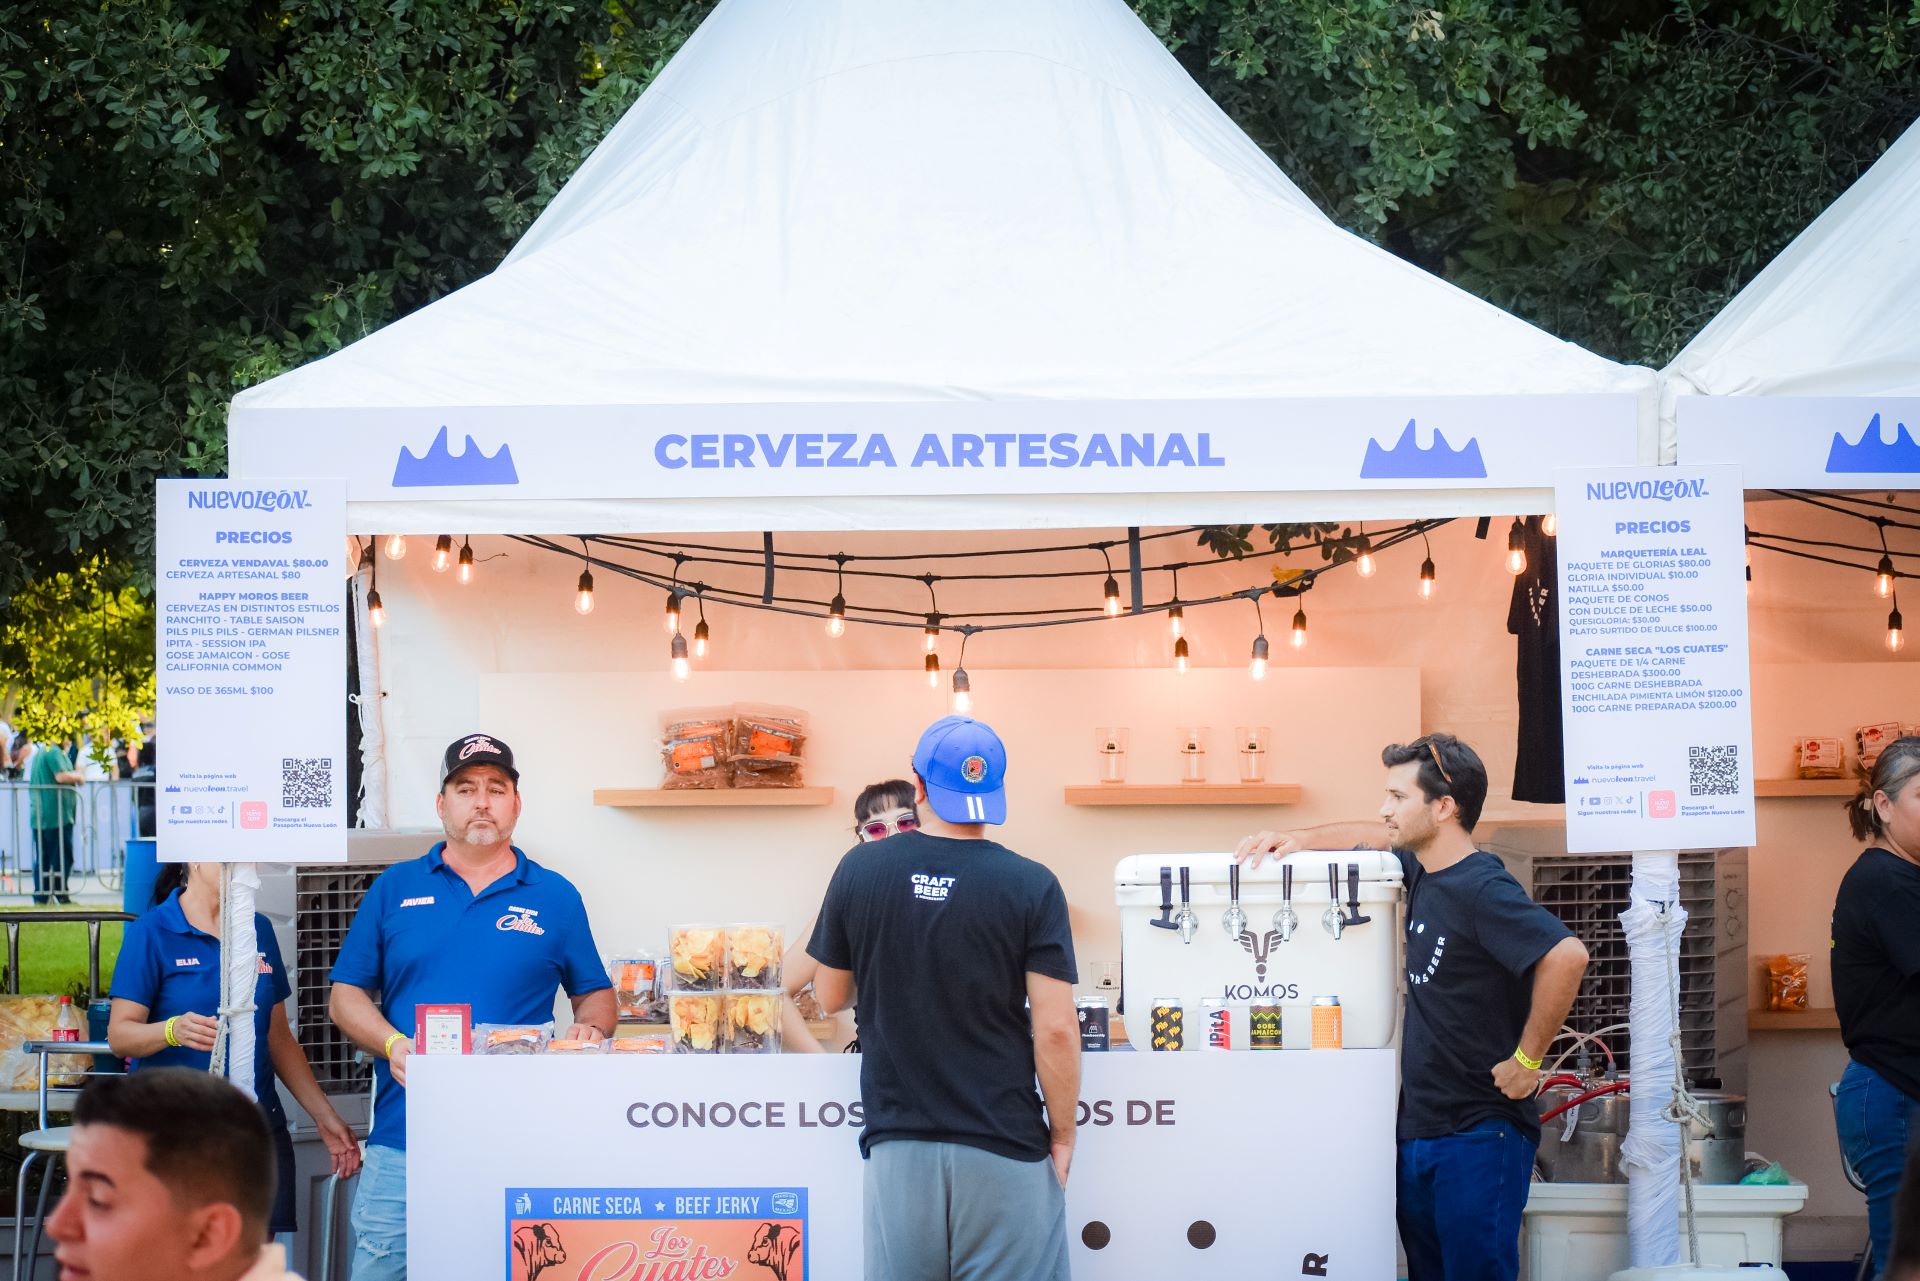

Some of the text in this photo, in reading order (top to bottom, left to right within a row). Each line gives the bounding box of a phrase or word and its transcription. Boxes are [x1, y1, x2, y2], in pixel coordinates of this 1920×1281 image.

[654, 433, 1225, 469] CERVEZA ARTESANAL
[1616, 520, 1691, 534] PRECIOS
[216, 531, 292, 544] PRECIOS
[1601, 547, 1707, 559] MARQUETERÍA LEAL
[179, 559, 328, 568] CERVEZA VENDAVAL $80.00
[1568, 559, 1711, 571] PAQUETE DE GLORIAS $80.00
[166, 571, 300, 579] CERVEZA ARTESANAL $80
[1568, 571, 1698, 581] GLORIA INDIVIDUAL $10.00
[1569, 584, 1644, 593] NATILLA $50.00
[199, 593, 309, 601] HAPPY MOROS BEER
[1569, 594, 1669, 605] PAQUETE DE CONOS
[166, 604, 339, 613] CERVEZAS EN DISTINTOS ESTILOS
[1569, 604, 1712, 615] CON DULCE DE LECHE $50.00
[167, 616, 220, 624] RANCHITO
[230, 616, 262, 624] TABLE
[266, 616, 304, 624] SAISON
[1569, 616, 1660, 626] QUESIGLORIA: $30.00
[167, 628, 188, 636] PILS
[192, 628, 213, 636] PILS
[216, 628, 238, 636] PILS
[248, 628, 293, 636] GERMAN
[296, 628, 339, 636] PILSNER
[1570, 624, 1717, 636] PLATO SURTIDO DE DULCE $100.00
[166, 640, 192, 648] IPITA
[202, 640, 245, 648] SESSION
[249, 640, 266, 648] IPA
[166, 652, 194, 660] GOSE
[197, 652, 252, 660] JAMAICON
[262, 652, 290, 660] GOSE
[1586, 645, 1728, 656] CARNE SECA "LOS CUATES"
[166, 663, 281, 671] CALIFORNIA COMMON
[1571, 657, 1685, 668] PAQUETE DE 1/4 CARNE
[1571, 669, 1680, 679] DESHEBRADA $300.00
[166, 687, 273, 695] VASO DE 365ML $100
[1571, 680, 1702, 691] 100G CARNE DESHEBRADA
[1572, 689, 1742, 701] ENCHILADA PIMIENTA LIMÓN $120.00
[1572, 701, 1736, 713] 100G CARNE PREPARADA $200.00
[911, 874, 956, 888] CRAFT
[914, 884, 949, 897] BEER
[400, 896, 434, 908] JAVIER
[176, 958, 200, 967] ELIA
[1225, 983, 1299, 1000] KOMOS
[627, 1101, 786, 1128] CONOCE
[799, 1101, 866, 1128] LOS
[1127, 1100, 1175, 1126] DE
[553, 1196, 760, 1215] CARNE SECA BEEF JERKY
[645, 1226, 693, 1259] Los
